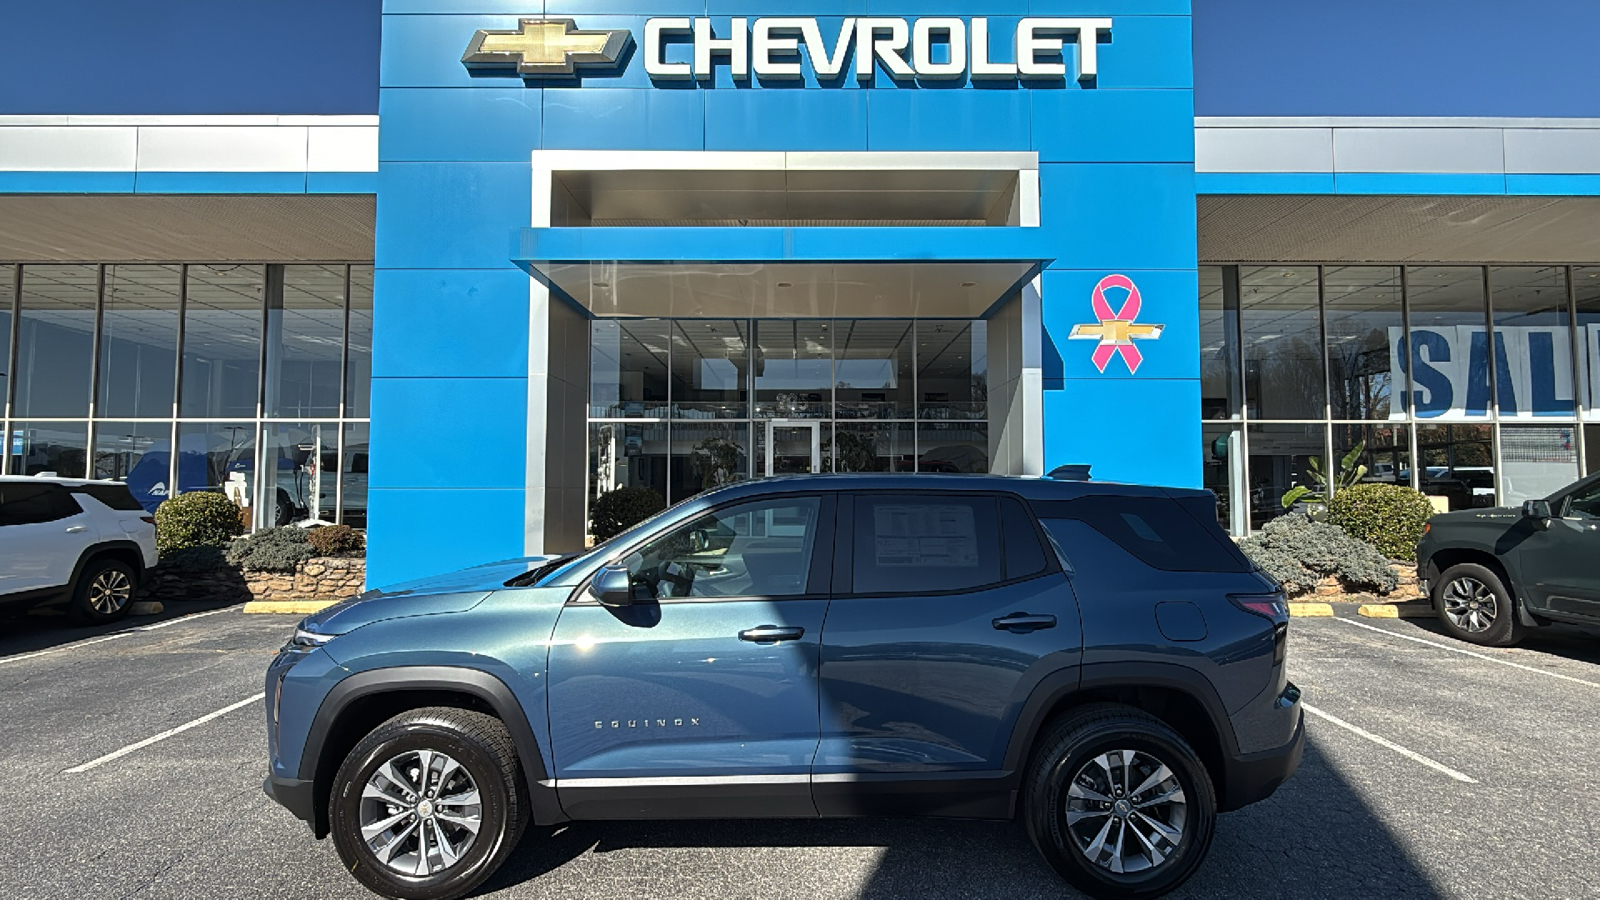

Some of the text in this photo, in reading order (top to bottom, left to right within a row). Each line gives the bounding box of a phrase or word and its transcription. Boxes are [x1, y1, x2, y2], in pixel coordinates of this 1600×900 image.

[643, 17, 1112, 80] CHEVROLET
[1397, 329, 1600, 418] SAL
[594, 717, 700, 729] EQUINOX
